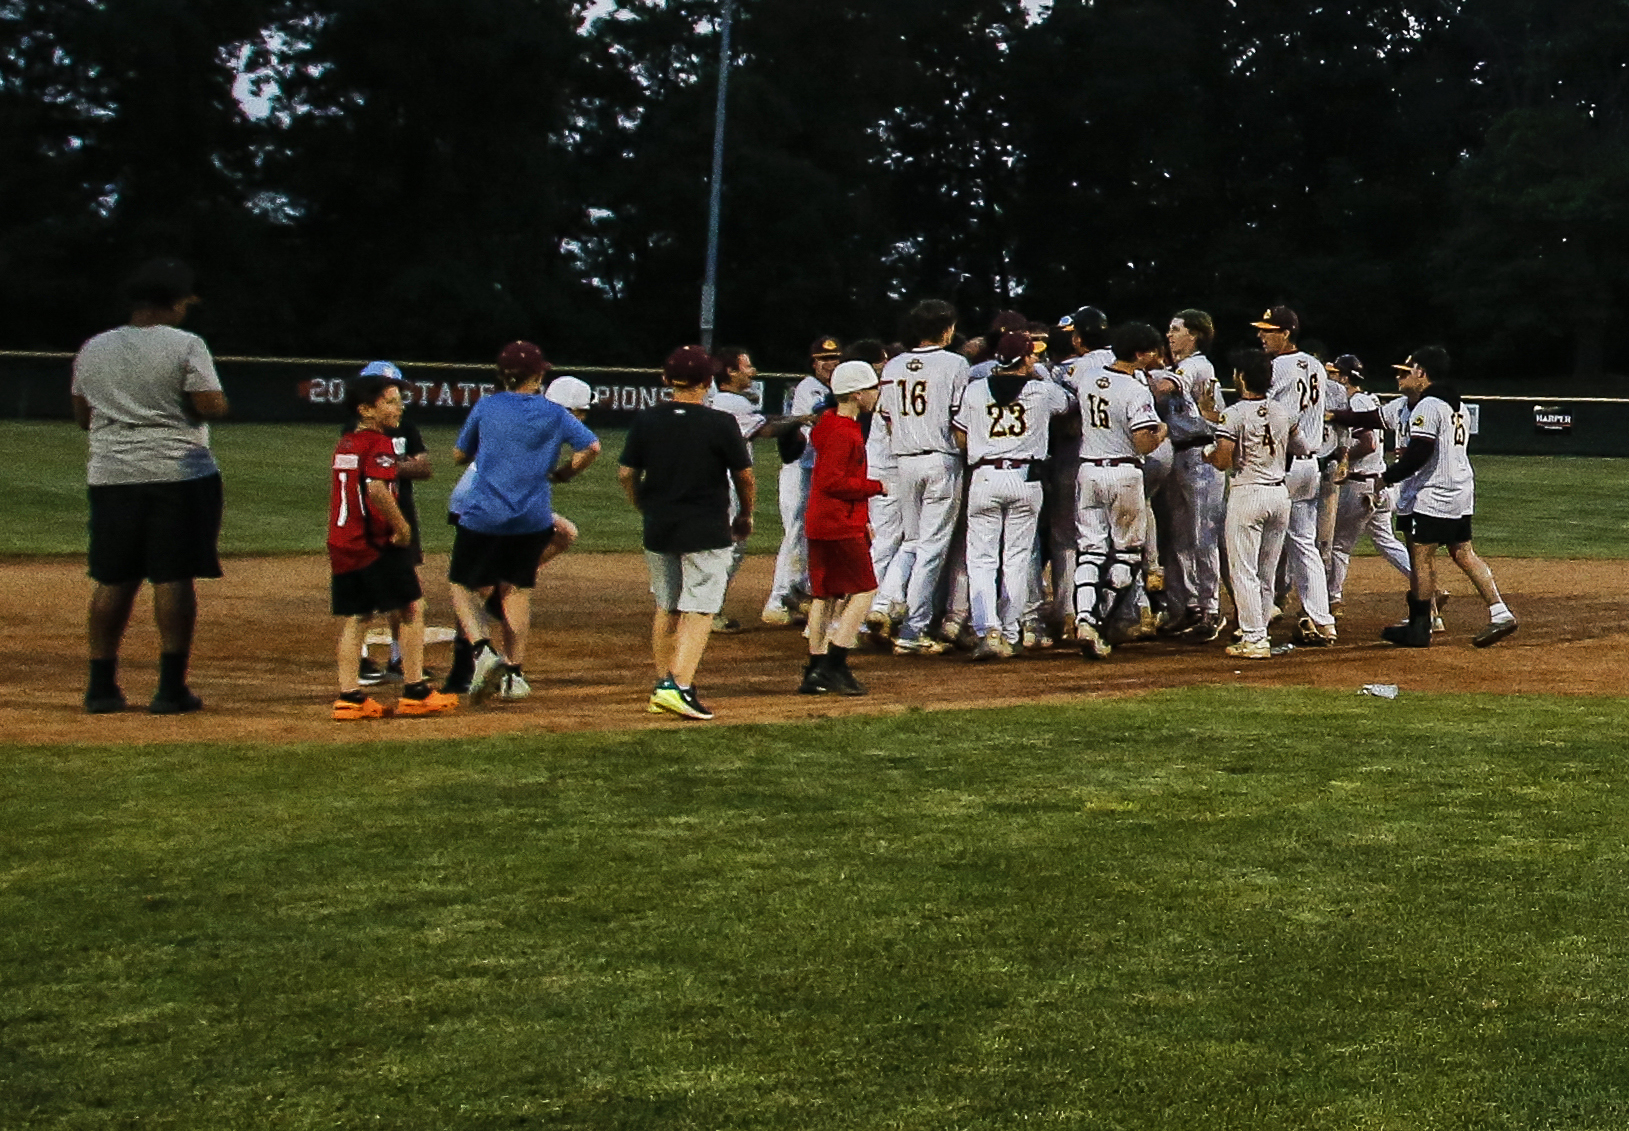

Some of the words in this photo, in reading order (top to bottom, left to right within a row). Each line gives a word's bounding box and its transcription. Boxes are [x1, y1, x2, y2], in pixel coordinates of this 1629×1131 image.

[309, 377, 345, 403] 20
[897, 378, 928, 417] 16
[986, 402, 1027, 438] 23
